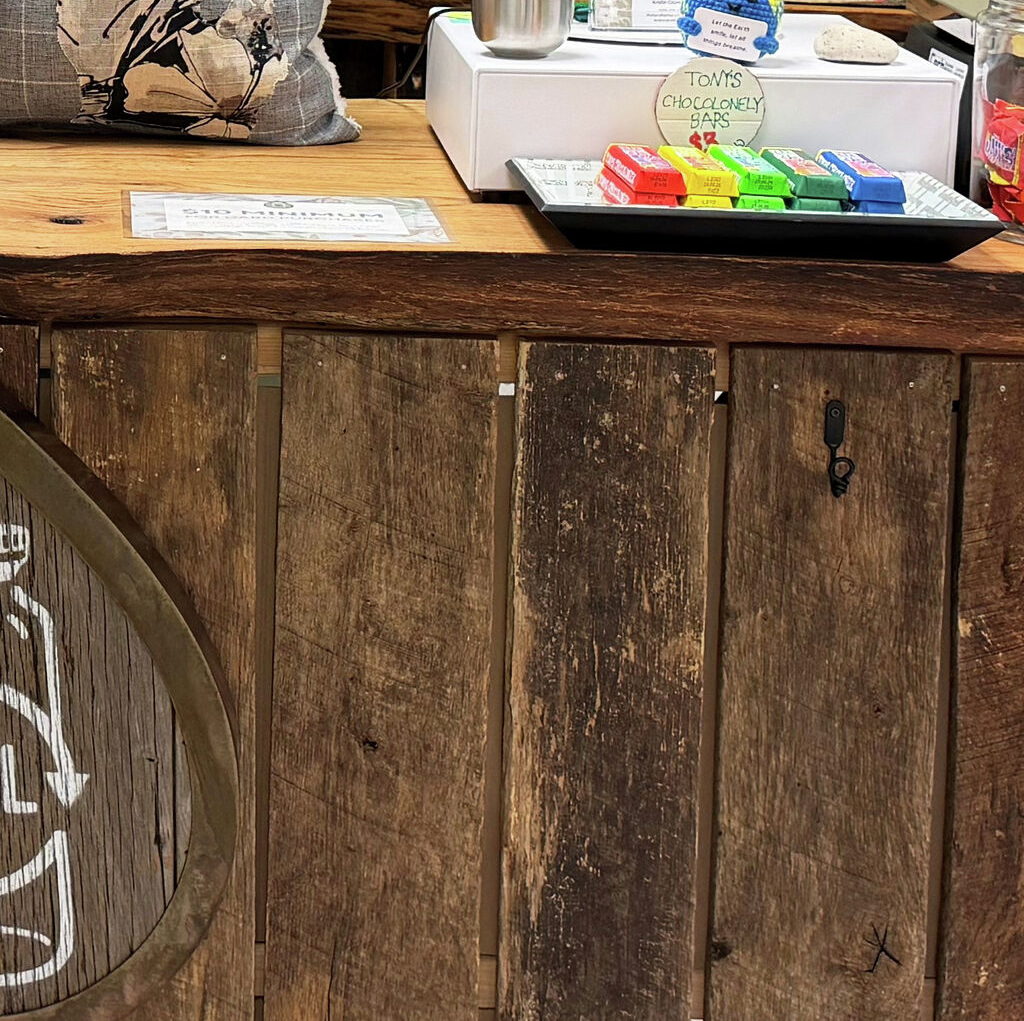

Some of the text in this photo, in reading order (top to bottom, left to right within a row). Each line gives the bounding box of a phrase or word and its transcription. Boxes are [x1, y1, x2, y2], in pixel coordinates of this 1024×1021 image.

[684, 69, 743, 89] TONY'S
[662, 94, 764, 114] CHOCOLONELY
[690, 112, 730, 130] BARS
[241, 210, 384, 219] MINIMUM
